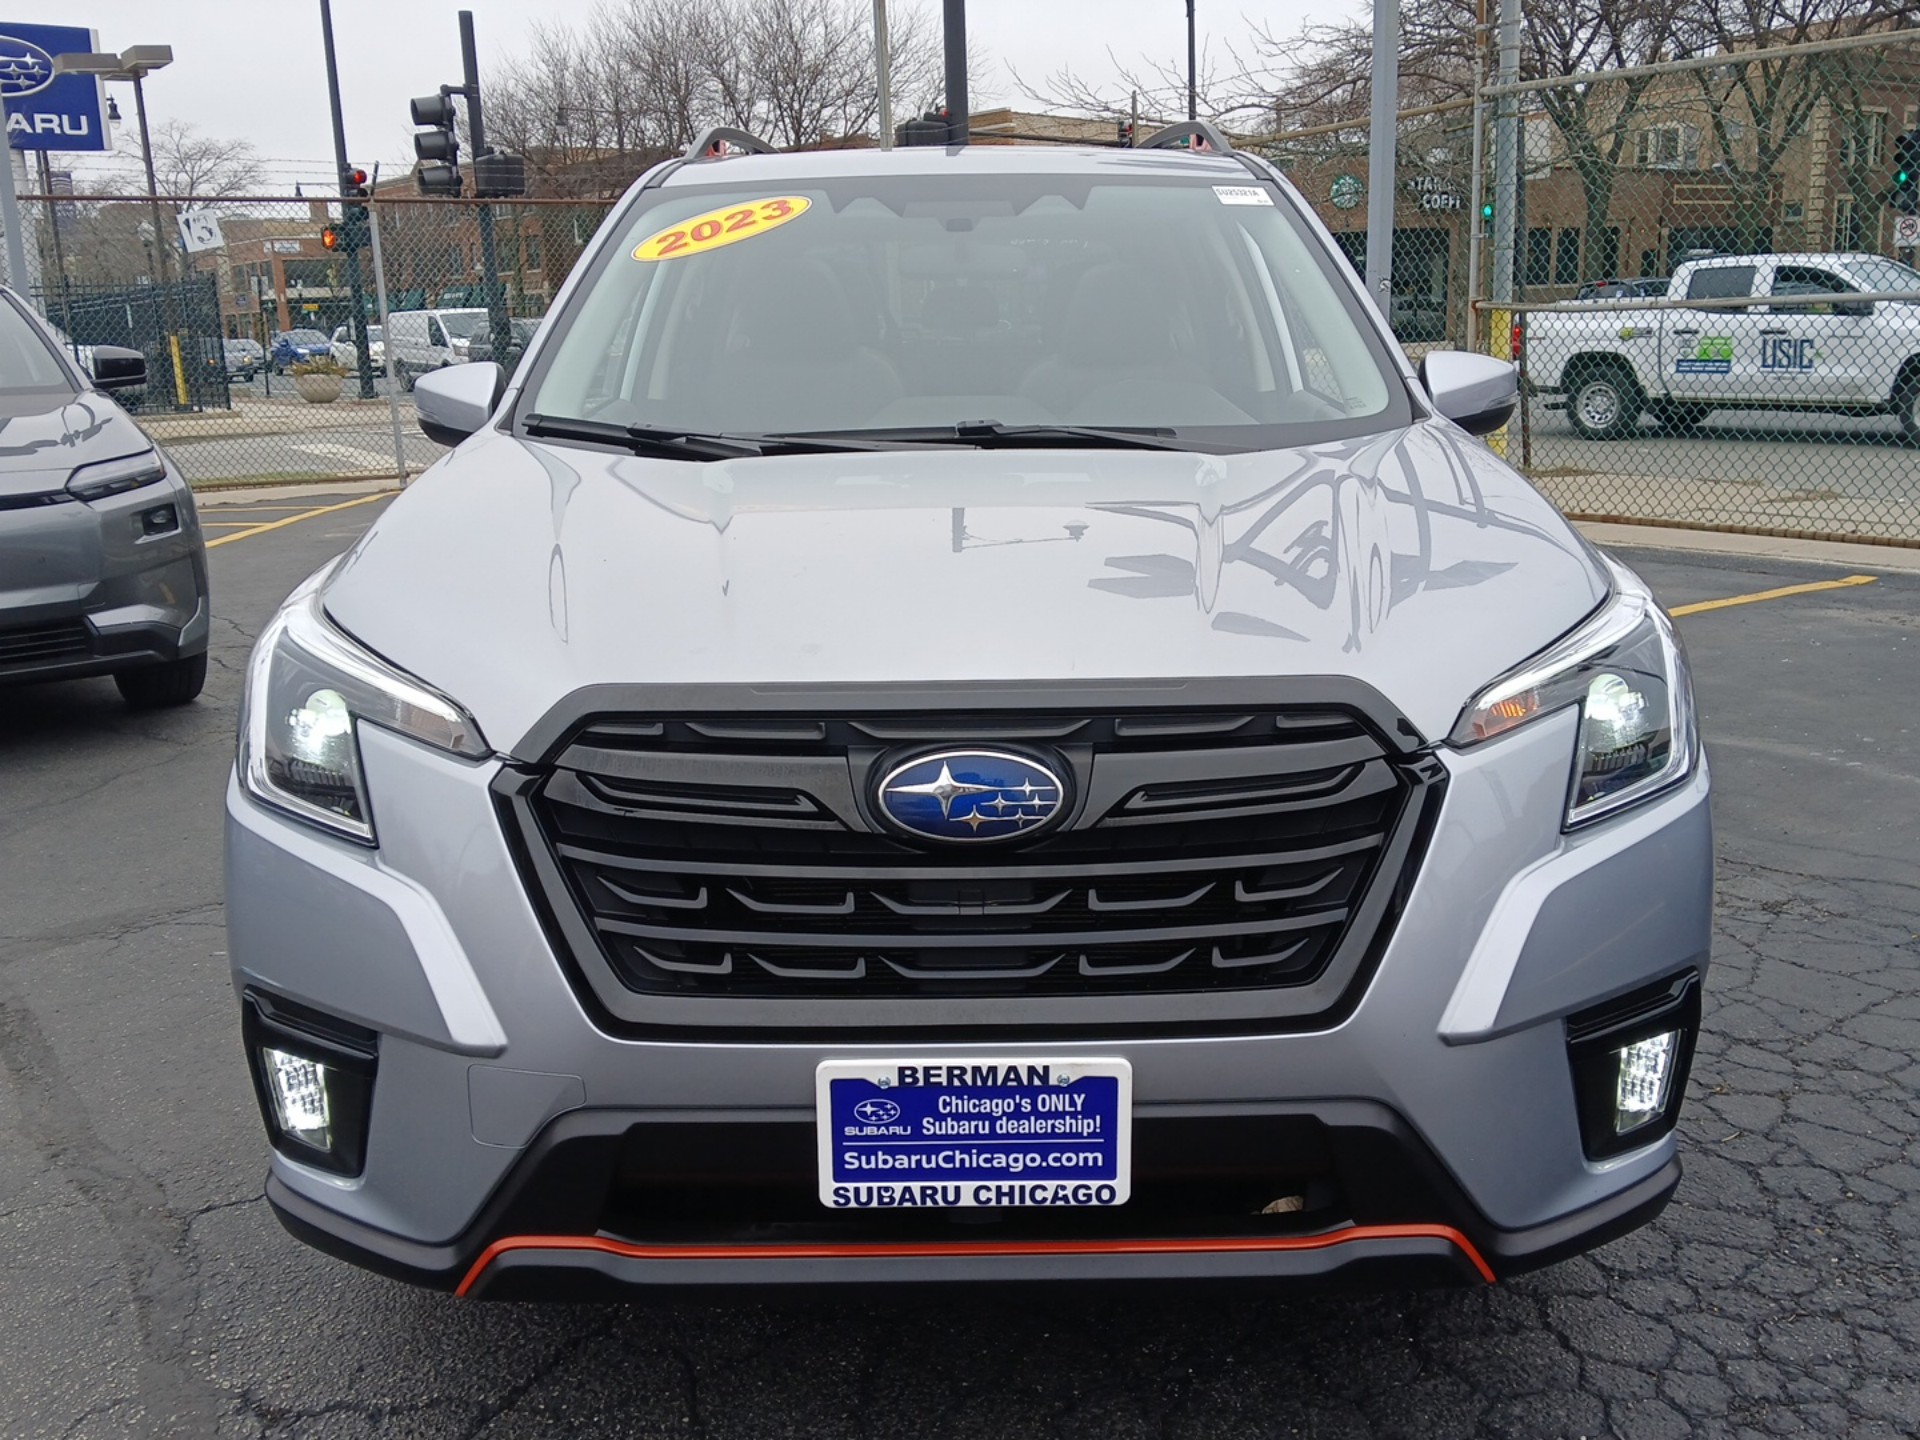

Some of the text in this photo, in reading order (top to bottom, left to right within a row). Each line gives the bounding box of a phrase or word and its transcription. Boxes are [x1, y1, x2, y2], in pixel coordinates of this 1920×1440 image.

[5, 112, 89, 135] ARU
[656, 199, 794, 257] 2023
[1762, 338, 1814, 369] USIC
[897, 1065, 1050, 1087] BERMAN
[938, 1093, 1086, 1116] Chicago's ONLY
[844, 1125, 911, 1136] SUBARU
[922, 1115, 1101, 1137] Subaru dealership!
[843, 1149, 1104, 1173] SubaruChicago.com
[832, 1184, 1117, 1207] SUBARU CHICAGO
